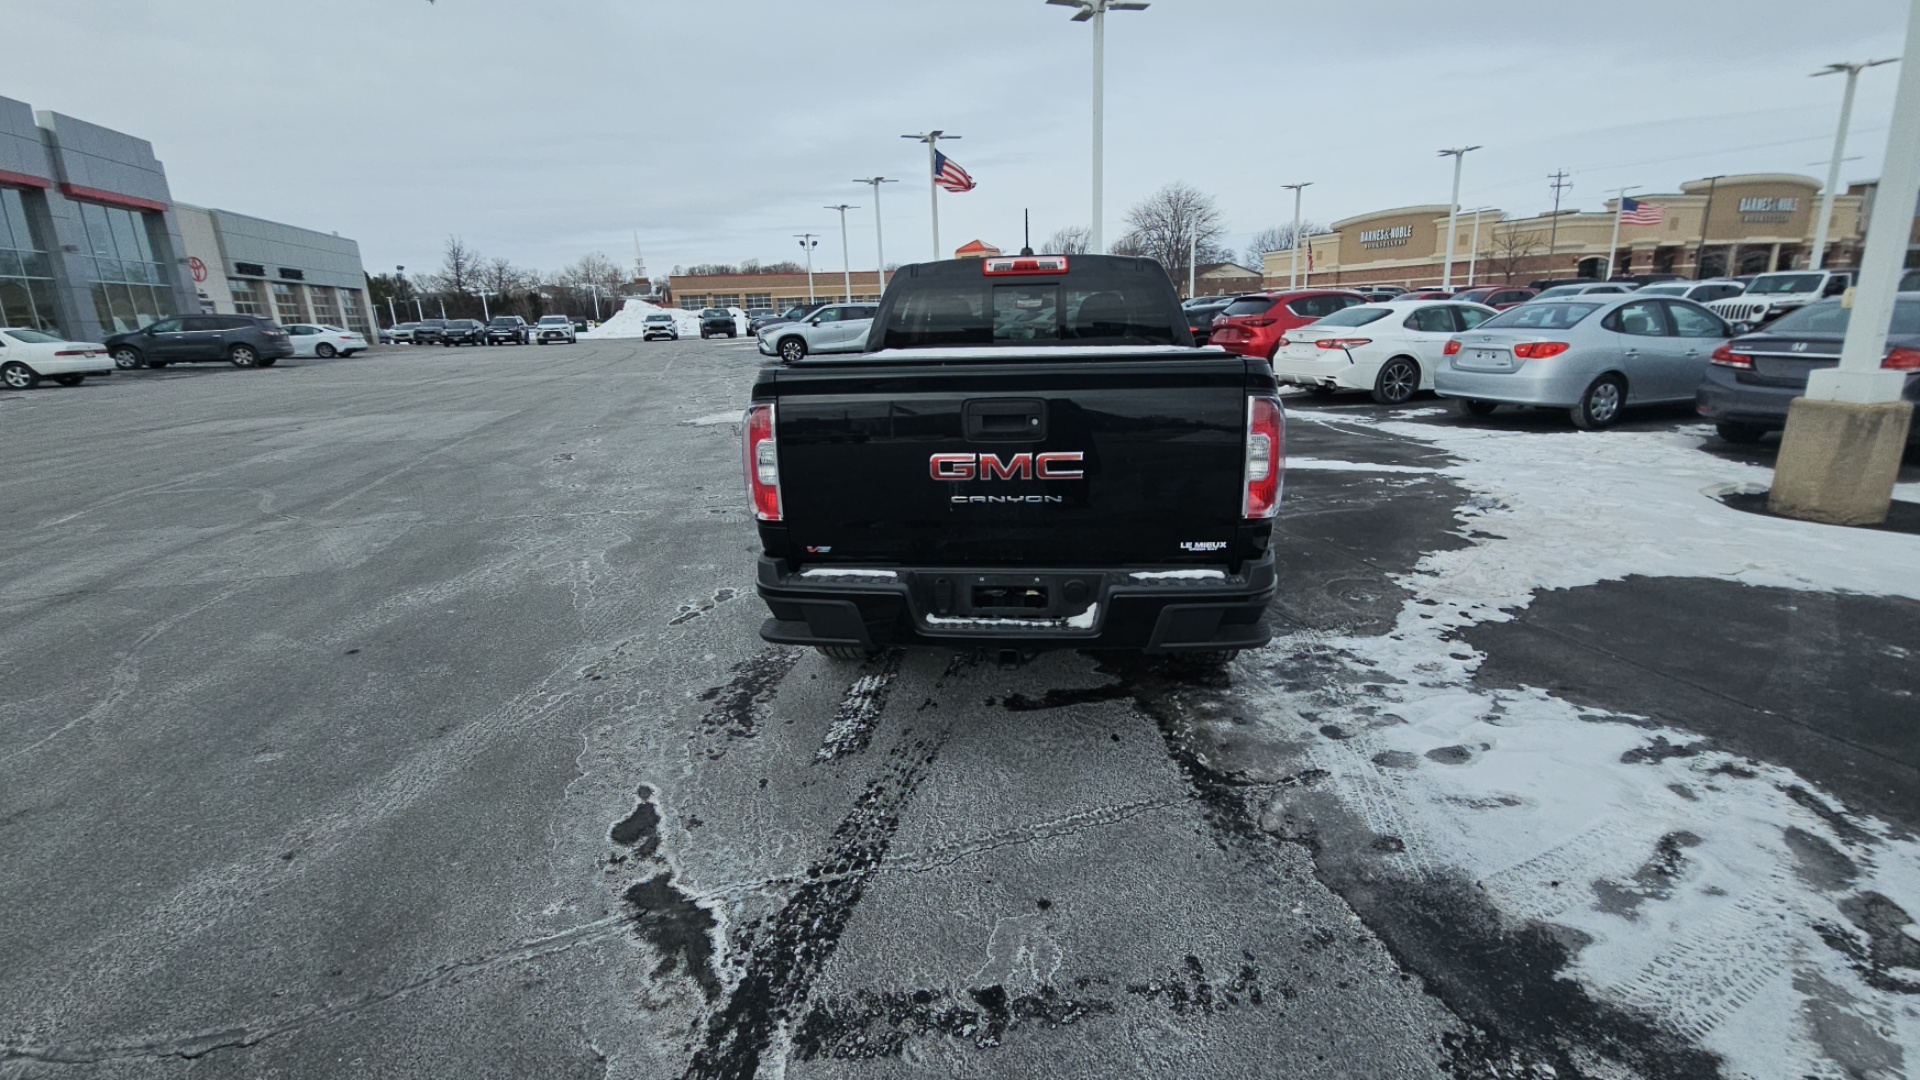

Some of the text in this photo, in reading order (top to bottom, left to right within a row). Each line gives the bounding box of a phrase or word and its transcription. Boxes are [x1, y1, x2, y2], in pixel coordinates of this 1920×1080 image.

[929, 451, 1084, 481] GMC
[950, 495, 1063, 503] CANYON
[1180, 541, 1193, 549] LE
